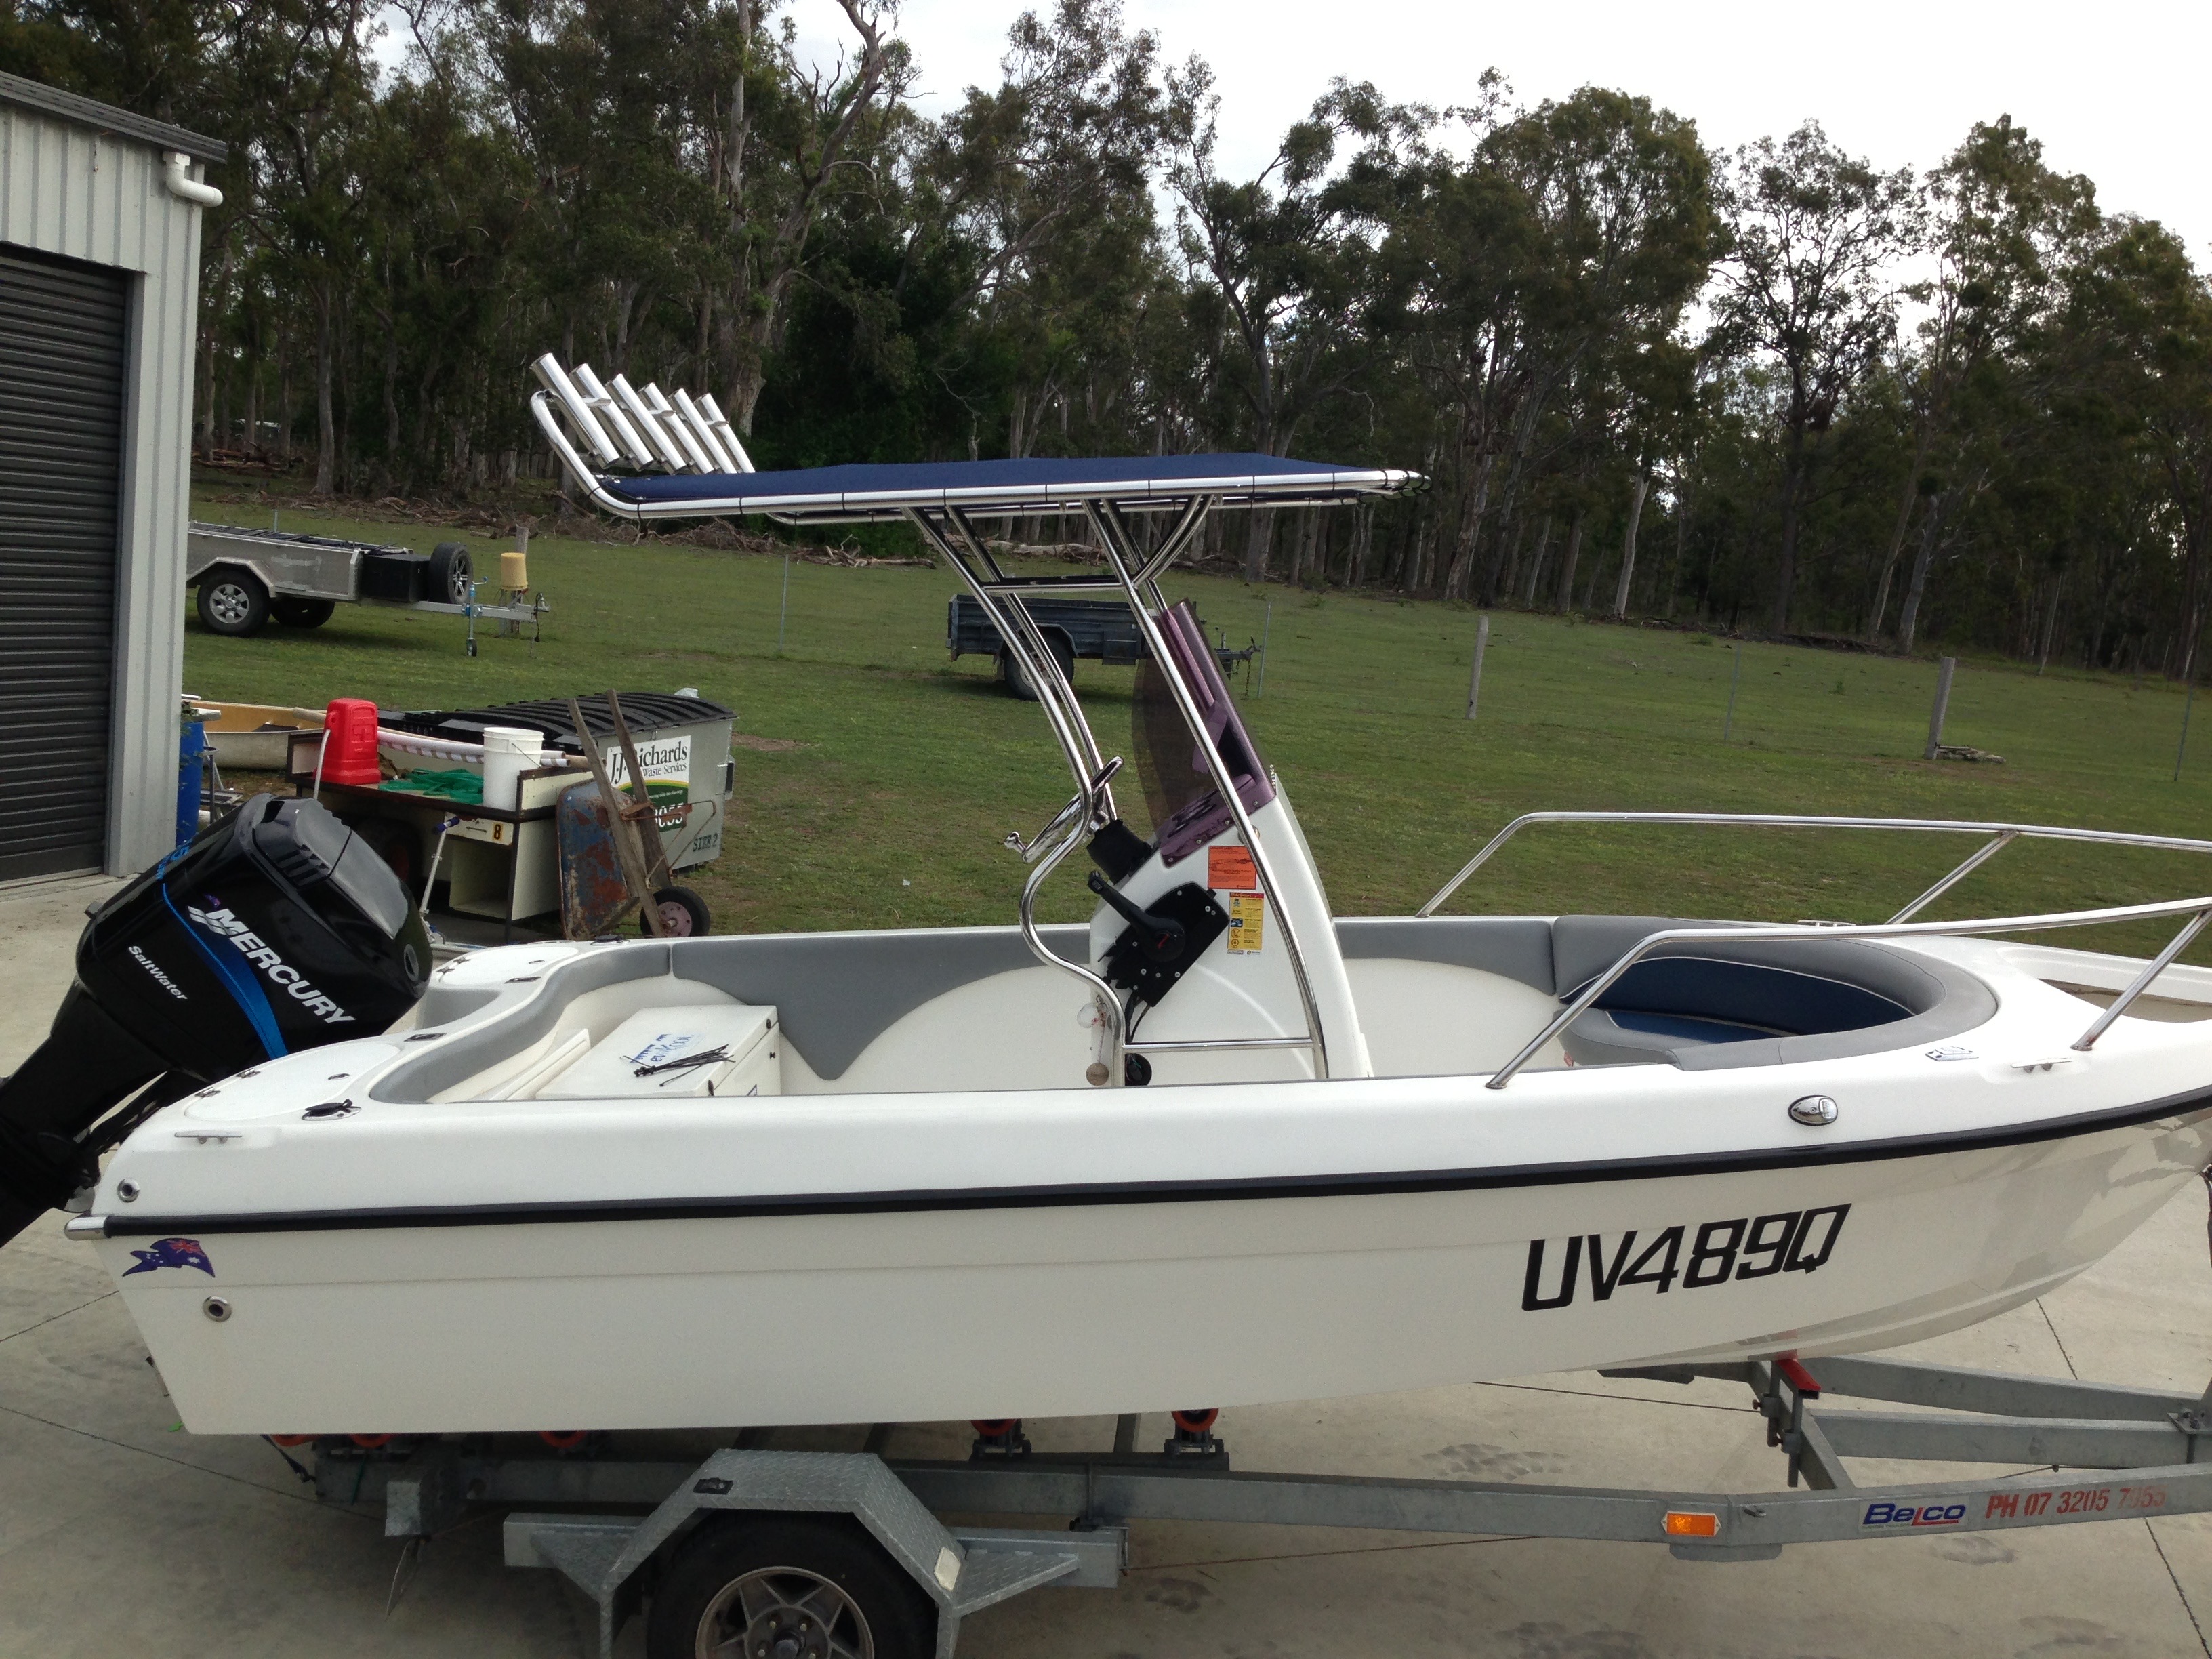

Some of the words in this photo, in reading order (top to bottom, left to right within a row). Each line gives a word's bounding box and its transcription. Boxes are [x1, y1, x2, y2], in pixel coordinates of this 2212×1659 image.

[638, 740, 688, 767] ichards
[642, 767, 662, 777] Waste
[663, 762, 687, 774] Services
[493, 823, 501, 840] 8
[712, 832, 718, 848] 2
[205, 908, 356, 1024] MERCURY
[1521, 1202, 1853, 1312] UV489Q
[1984, 1493, 2020, 1519] PH
[2023, 1492, 2053, 1517] 07
[2056, 1488, 2111, 1515] 3205
